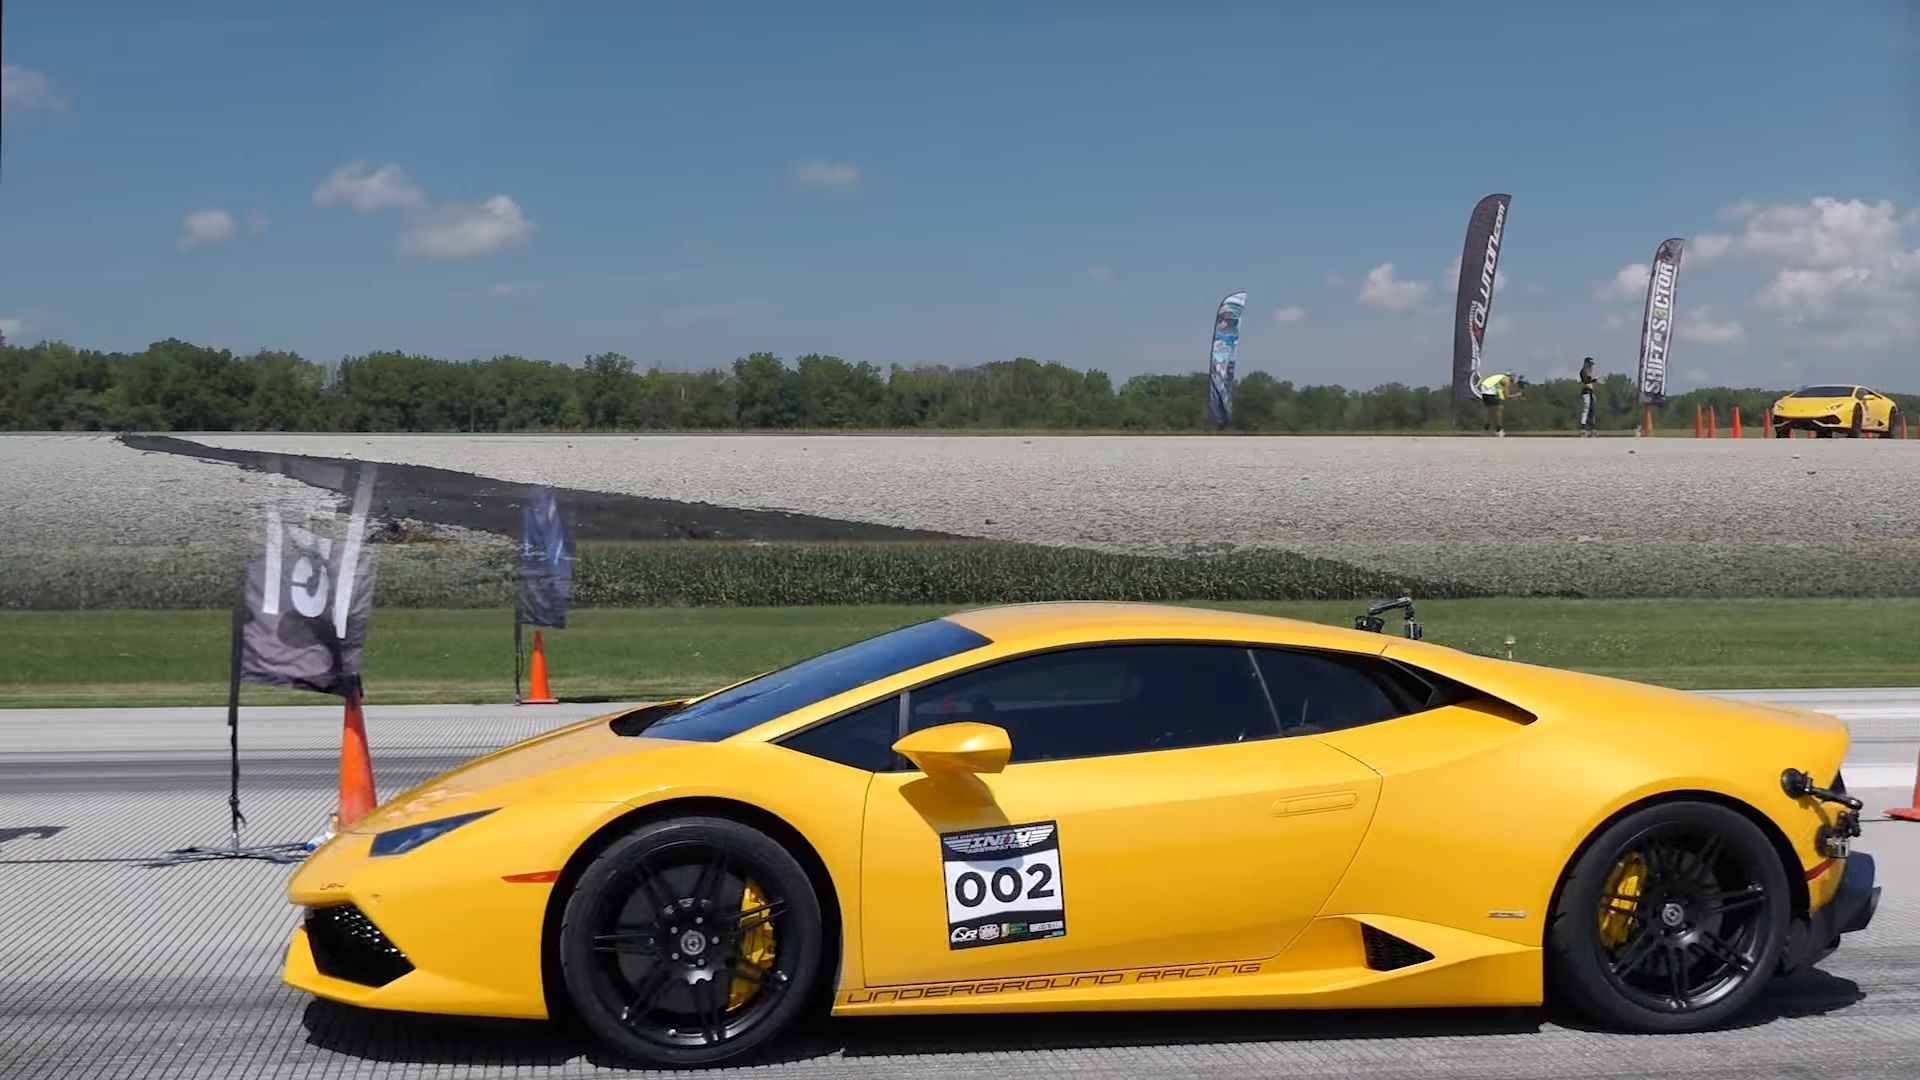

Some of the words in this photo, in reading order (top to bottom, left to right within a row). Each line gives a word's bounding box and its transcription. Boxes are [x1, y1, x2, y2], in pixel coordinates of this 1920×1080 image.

[1645, 341, 1664, 393] SHIFT
[955, 863, 1054, 907] 002
[848, 974, 1124, 1003] UNDERGROUND
[1136, 963, 1261, 982] RACING
